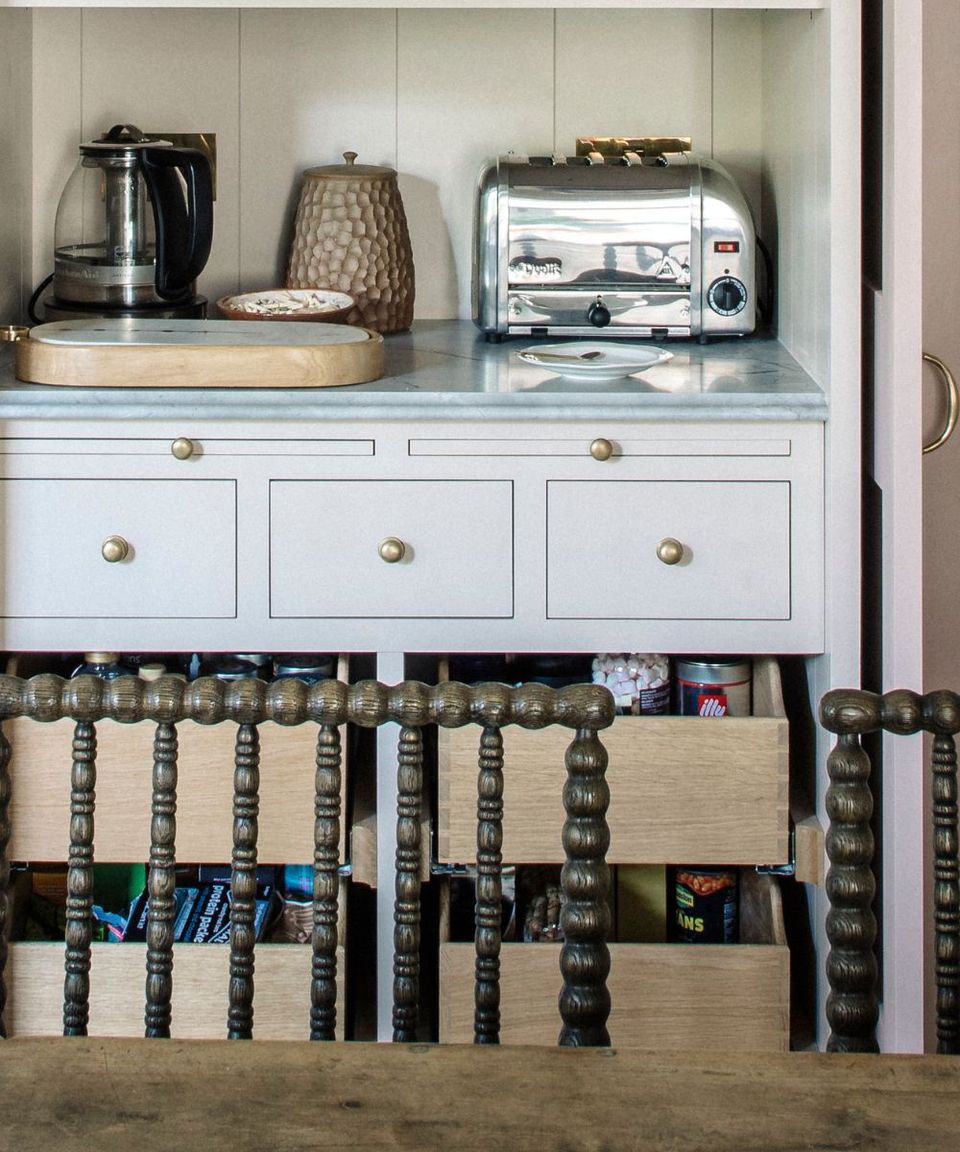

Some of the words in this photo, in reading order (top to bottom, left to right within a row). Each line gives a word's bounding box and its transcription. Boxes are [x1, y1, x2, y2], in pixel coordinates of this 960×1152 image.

[699, 698, 726, 716] illy
[204, 885, 225, 915] protein
[193, 916, 212, 943] packe
[678, 912, 704, 932] ANS
